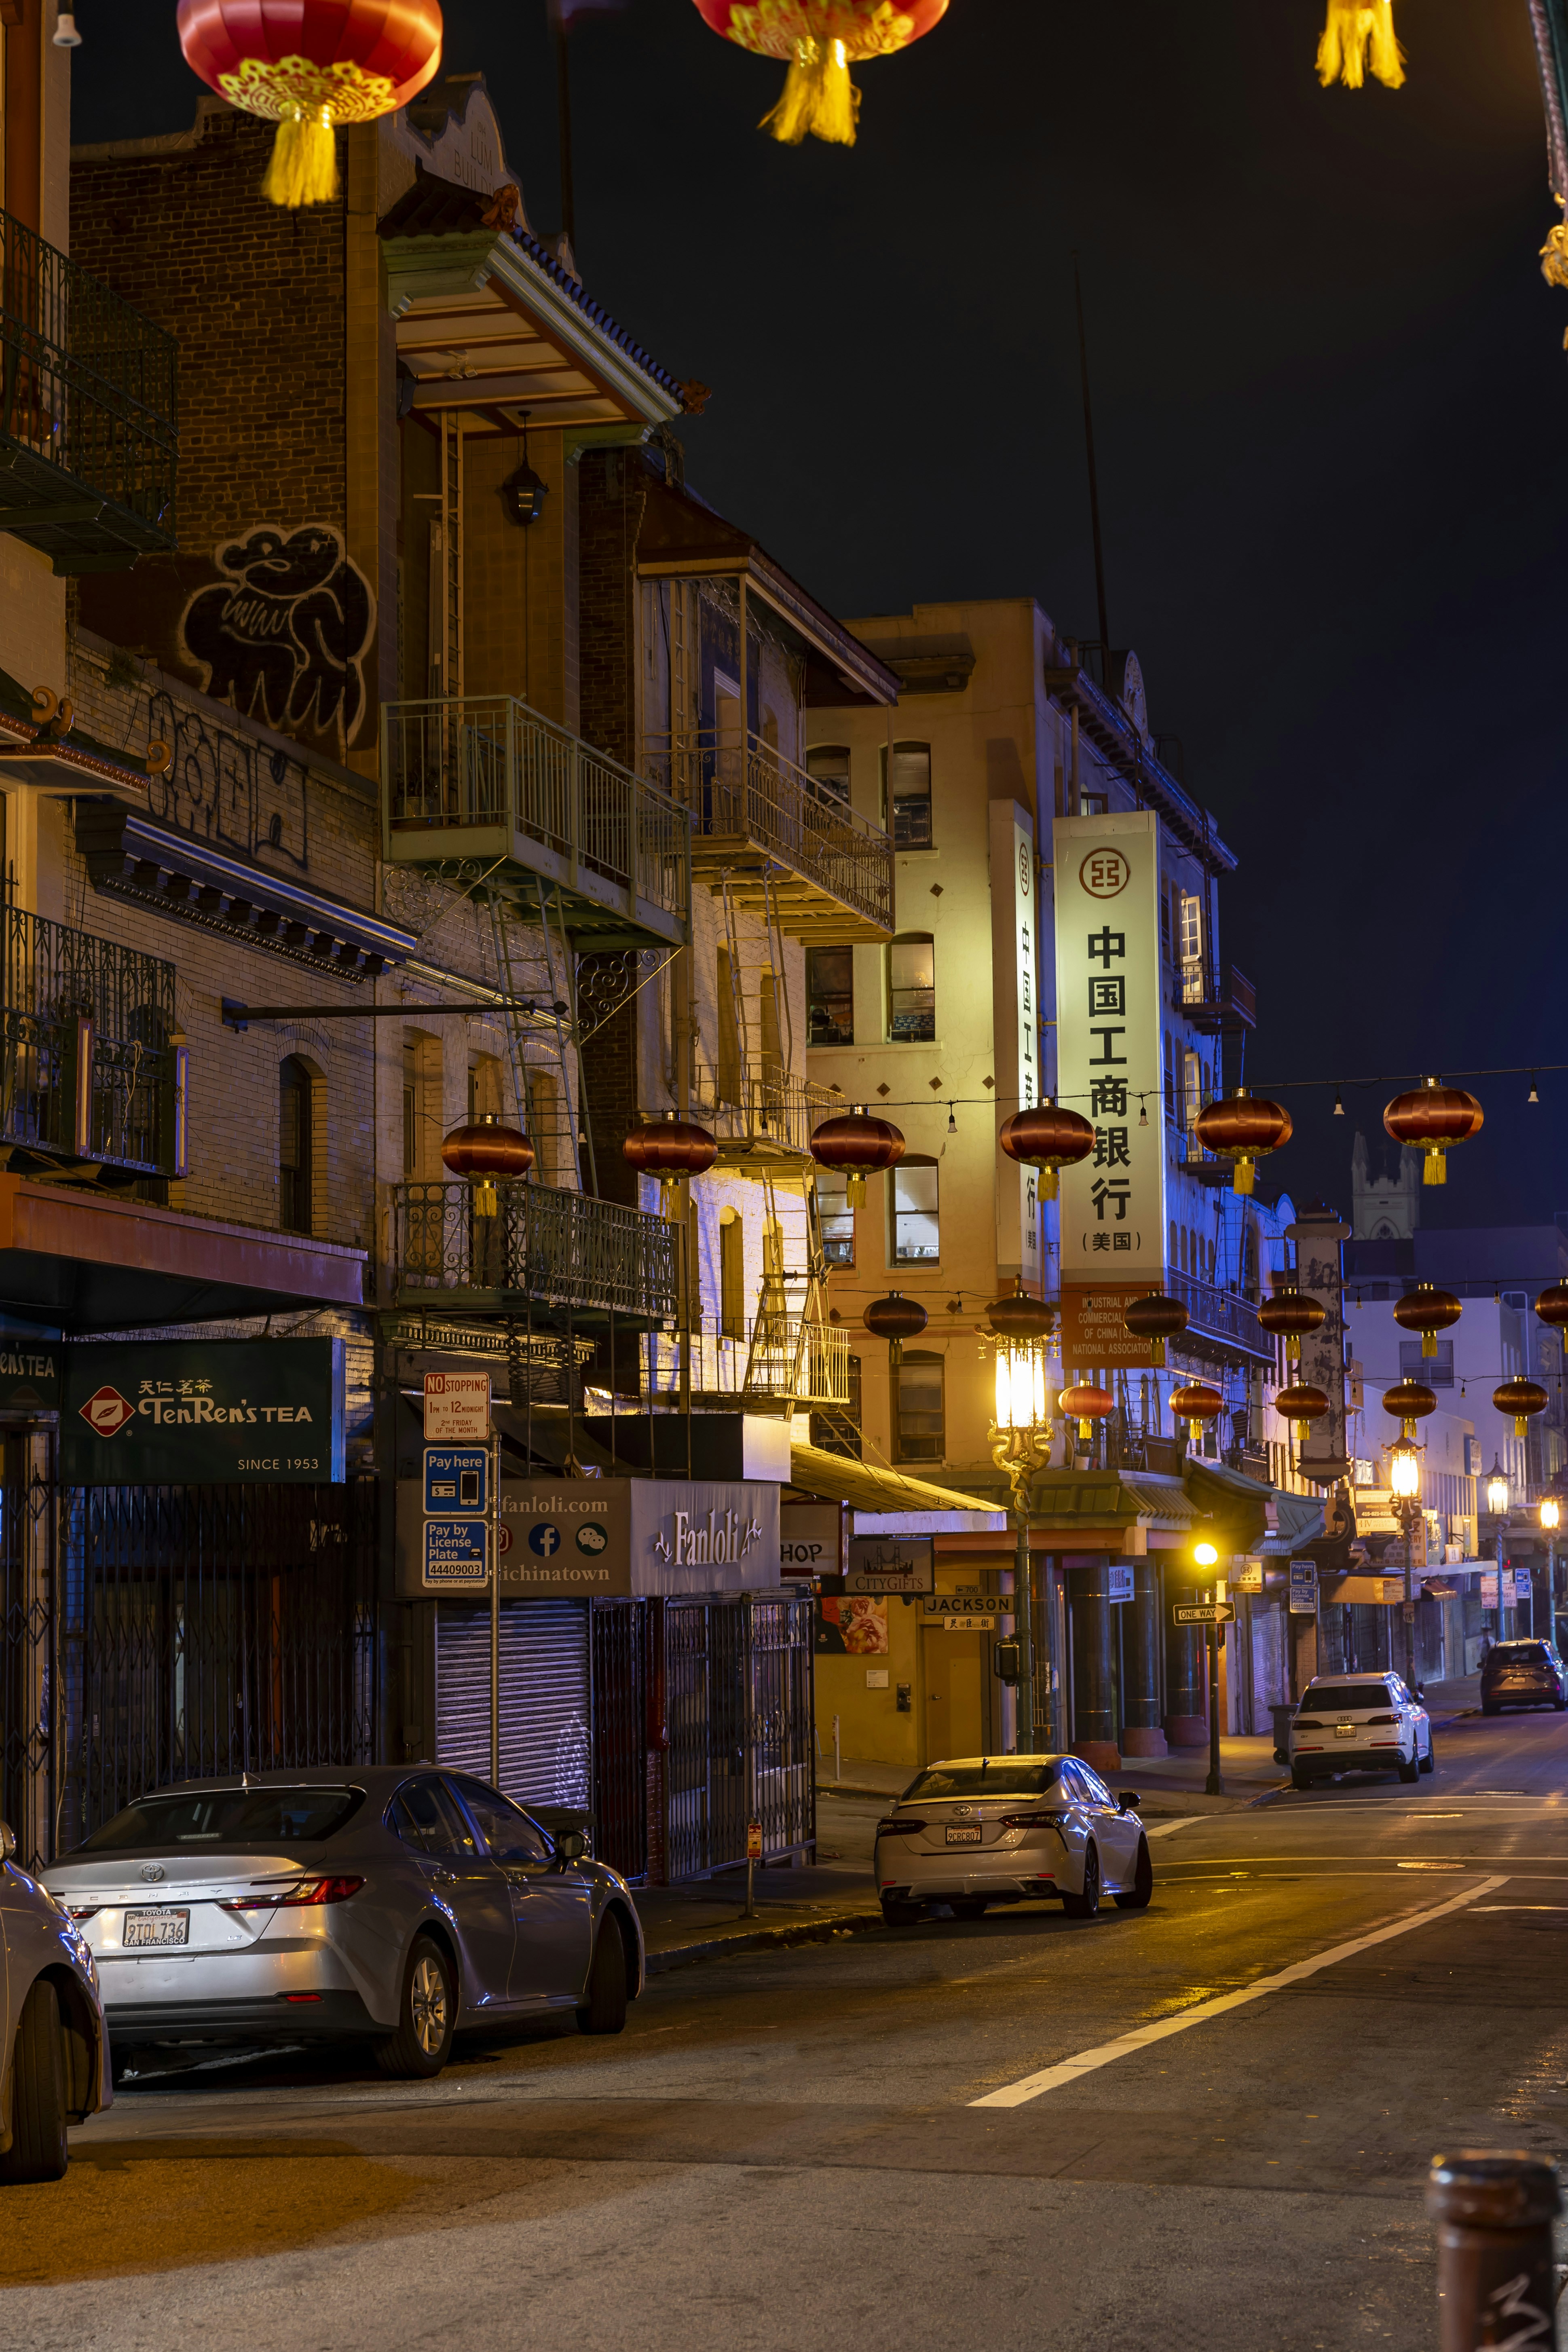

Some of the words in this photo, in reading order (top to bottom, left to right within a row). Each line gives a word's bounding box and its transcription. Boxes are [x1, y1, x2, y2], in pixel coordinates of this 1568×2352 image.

[1022, 921, 1035, 1219] 中国工商行
[1088, 926, 1131, 1220] 中国工商银行
[1083, 1232, 1141, 1252] (美国)
[1082, 1297, 1122, 1308] INDUSTRIAL
[1078, 1312, 1123, 1323] COMMERCIAL
[1084, 1328, 1093, 1339] OF
[1097, 1328, 1118, 1339] CHINA
[1073, 1344, 1105, 1355] NATIONAL
[1109, 1343, 1151, 1354] ASSOCIATION
[26, 1355, 54, 1378] TEA
[138, 1379, 213, 1395] 天仁茗茶
[428, 1376, 443, 1392] NO
[446, 1380, 486, 1392] STOPPING
[429, 1401, 440, 1413] 1PM
[260, 1407, 313, 1422] TEA
[238, 1459, 279, 1470] SINCE
[287, 1459, 318, 1469] 1953
[429, 1456, 452, 1470] Pay
[454, 1455, 482, 1467] here
[501, 1496, 608, 1513] fanloli.com
[429, 1525, 450, 1538] Pay
[454, 1524, 468, 1538] by
[673, 1508, 739, 1566] Fanloli
[429, 1536, 471, 1547] License
[429, 1549, 458, 1559] Plate
[780, 1544, 822, 1563] HOP
[430, 1565, 480, 1574] 44409003
[928, 1598, 1009, 1611] JACKSON
[1181, 1610, 1196, 1619] ONE
[1200, 1609, 1216, 1617] WAY
[948, 1832, 979, 1841] 9CRC807
[89, 1889, 223, 1901] CAMRY
